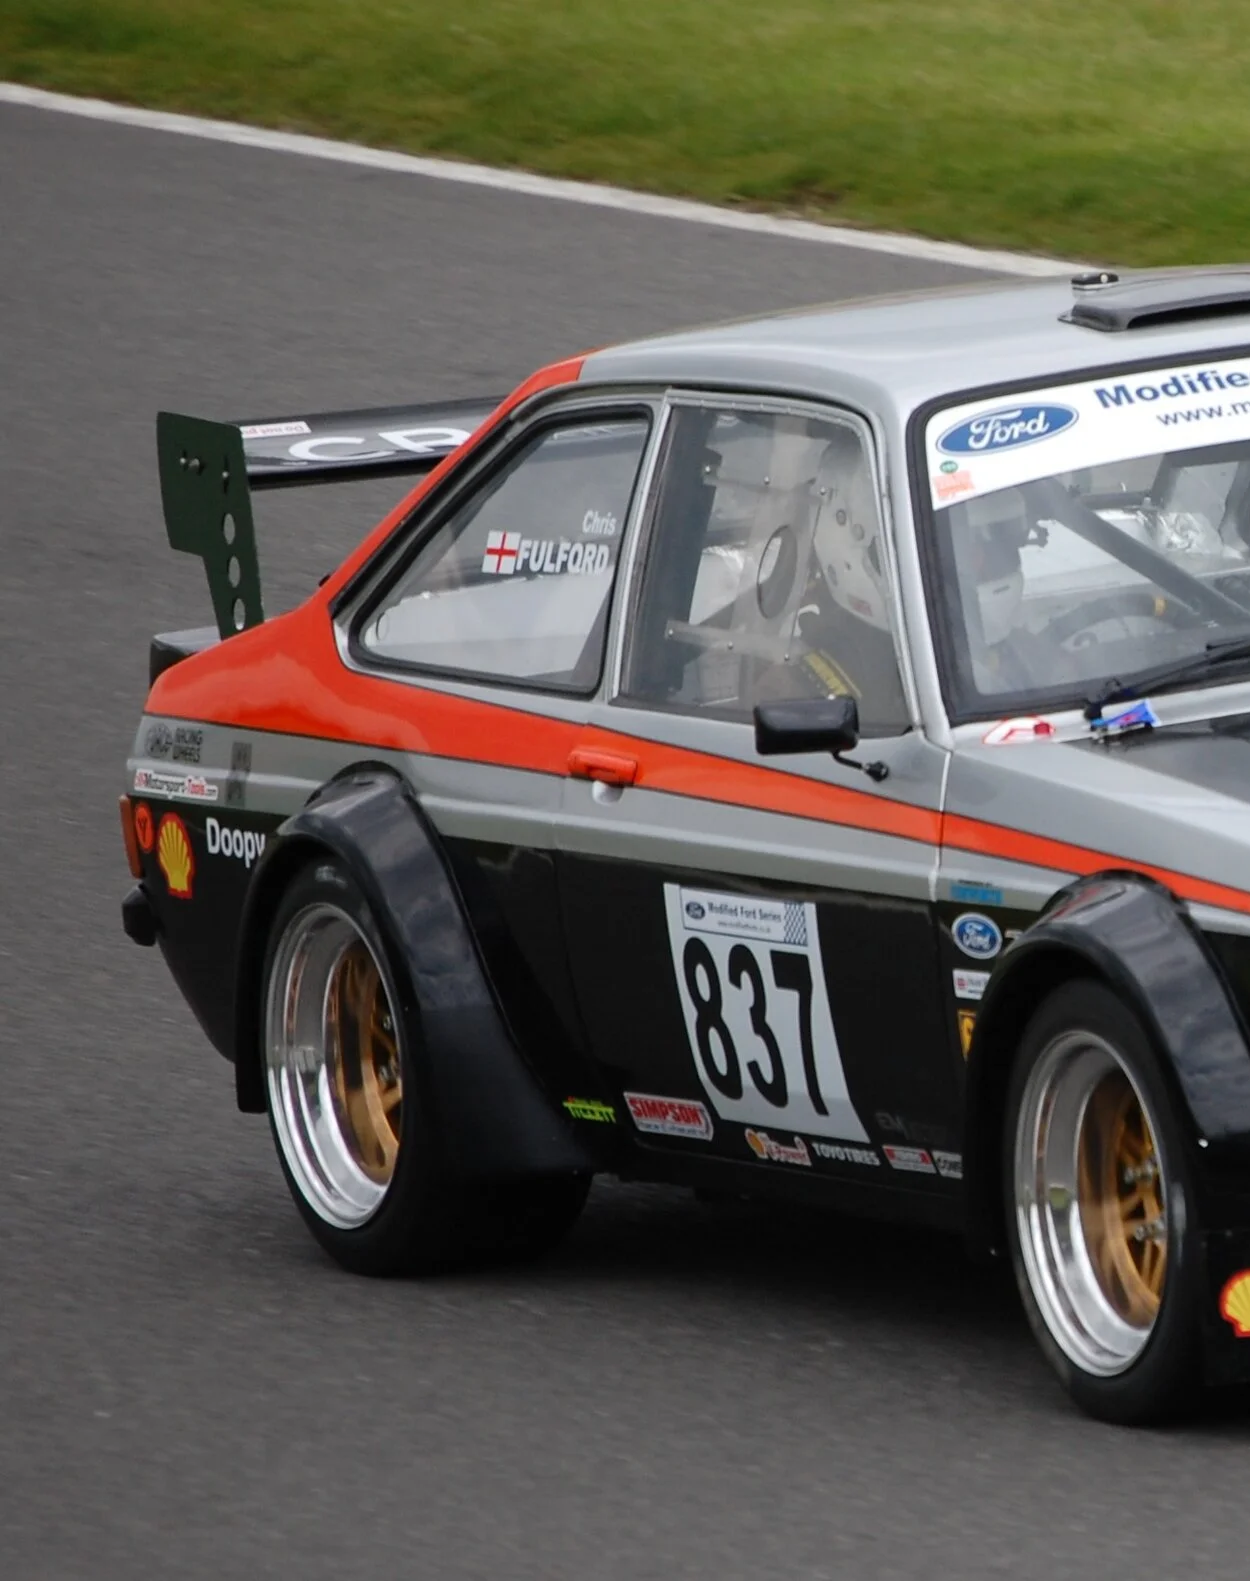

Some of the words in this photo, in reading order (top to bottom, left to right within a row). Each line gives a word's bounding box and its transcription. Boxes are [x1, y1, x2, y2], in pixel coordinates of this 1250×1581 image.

[967, 409, 1051, 449] Ford
[582, 509, 617, 535] Chris
[515, 539, 610, 574] FULFORD
[683, 936, 830, 1118] 837
[629, 1096, 704, 1126] SIMPSON
